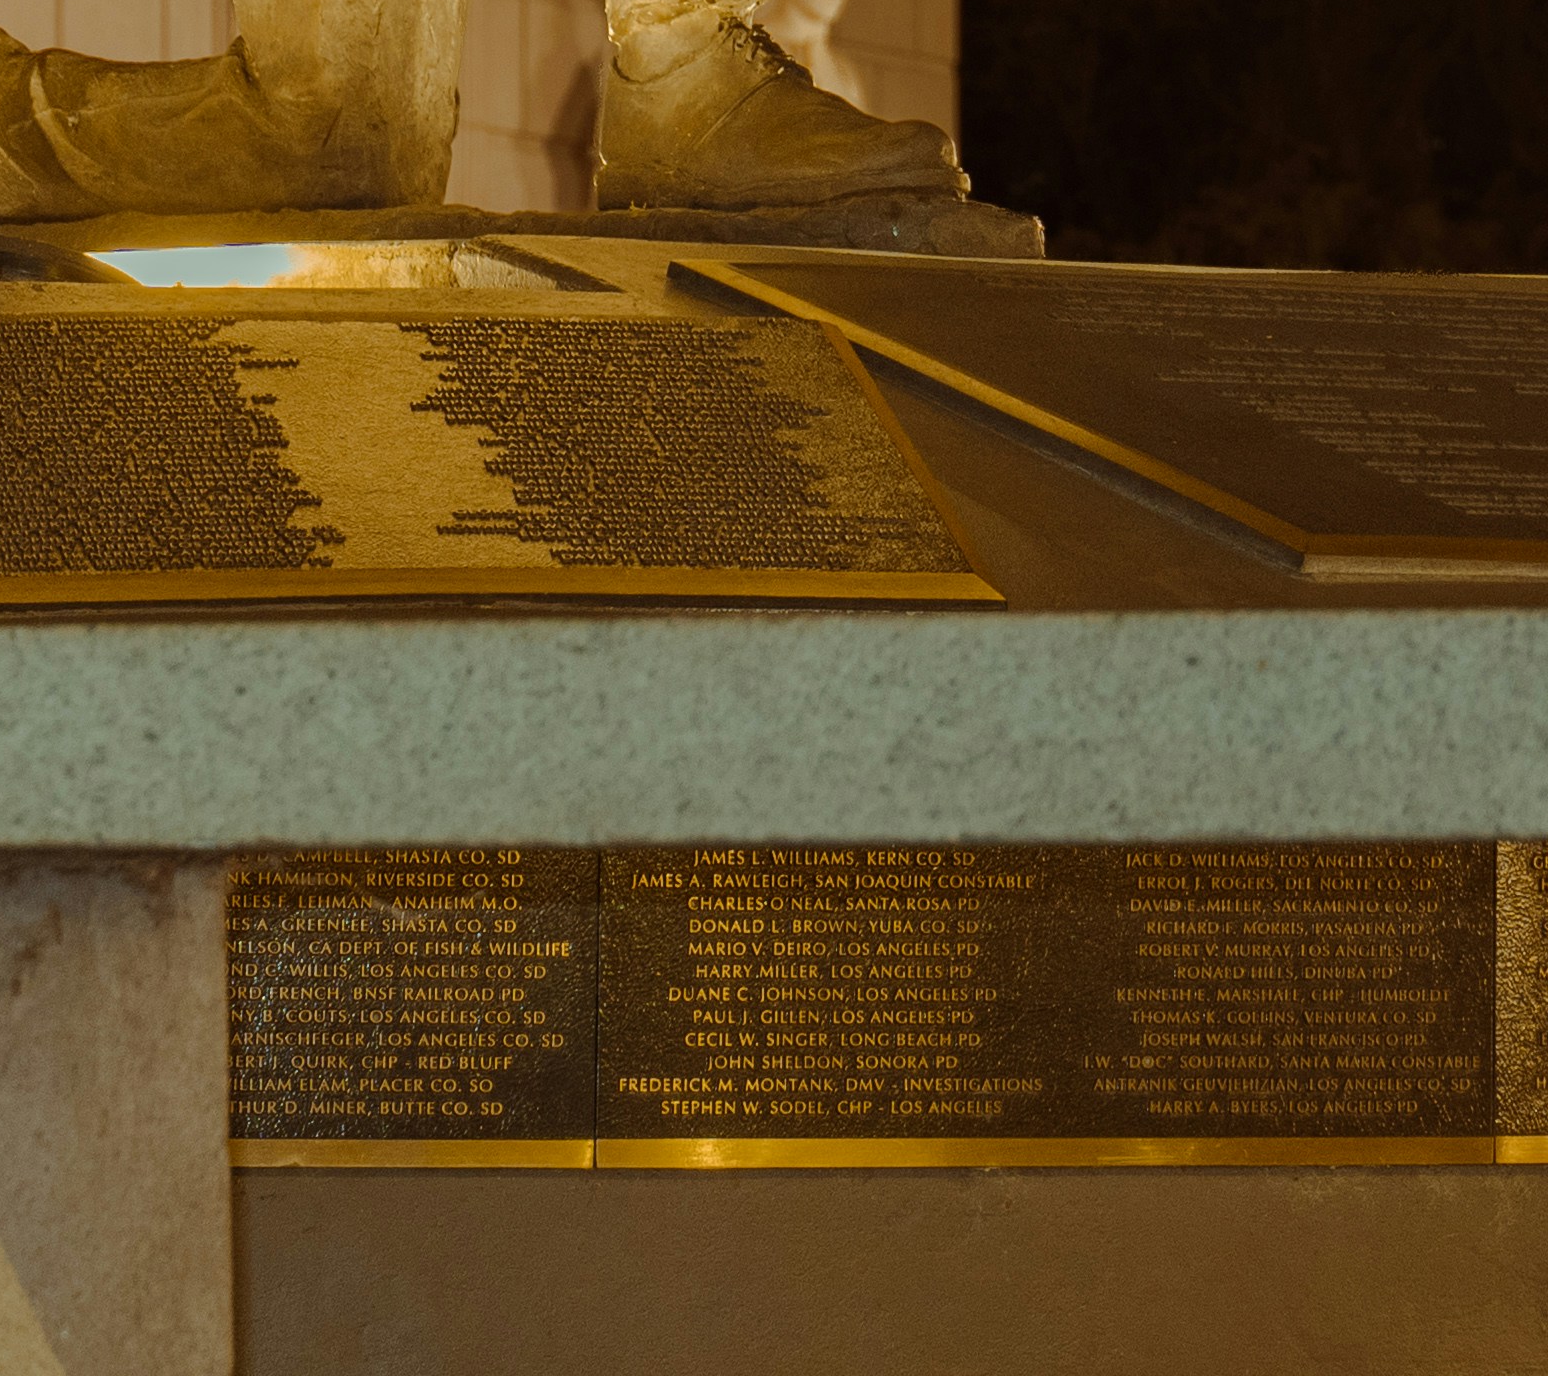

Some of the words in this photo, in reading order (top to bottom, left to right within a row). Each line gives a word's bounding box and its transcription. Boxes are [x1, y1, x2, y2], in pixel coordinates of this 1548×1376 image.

[384, 849, 452, 866] SHASTA
[496, 849, 521, 866] SD
[692, 849, 745, 868] JAMES
[751, 849, 766, 868] L.
[771, 849, 860, 868] WILLIAMS,
[866, 849, 910, 868] KERN
[915, 849, 946, 868] CO.
[951, 849, 975, 868] SD
[257, 872, 359, 889] HAMILTON,
[365, 872, 455, 889] RIVERSIDE
[461, 872, 494, 889] CO.
[500, 872, 524, 889] SD
[630, 873, 683, 891] JAMES
[687, 873, 706, 891] A.
[712, 873, 808, 891] RAWLEIGH,
[813, 873, 848, 891] SAN
[854, 873, 931, 891] JOAQUIN
[937, 873, 1036, 891] CONSTABLE
[686, 895, 763, 913] CHARLES
[770, 895, 838, 913] O'NEAL,
[844, 895, 901, 913] SANTA
[905, 895, 951, 913] ROSA
[956, 895, 980, 913] PD
[687, 918, 764, 935] DONALD
[771, 918, 785, 935] L.
[791, 918, 863, 935] BROWN,
[868, 918, 914, 935] YUBA
[919, 918, 949, 935] CO.
[956, 918, 979, 935] SD
[307, 940, 332, 958] CA
[393, 940, 418, 958] OF
[424, 940, 463, 958] FISH
[470, 940, 482, 958] &
[488, 940, 570, 958] WILDLIFE
[686, 940, 746, 958] MARIO
[751, 940, 767, 958] V.
[773, 940, 832, 958] DEIRO,
[837, 940, 870, 958] LOS
[875, 940, 950, 958] ANGELES
[955, 940, 979, 958] PD
[695, 963, 752, 981] HARRY
[757, 963, 824, 981] MILLER,
[830, 963, 863, 981] LOS
[868, 963, 943, 981] ANGELES
[948, 963, 972, 981] PD
[269, 986, 346, 1003] FRENCH,
[352, 986, 397, 1003] BNSF
[403, 986, 494, 1003] RAILROAD
[500, 986, 525, 1003] PD
[667, 986, 731, 1004] DUANE
[735, 986, 753, 1004] C.
[758, 986, 849, 1004] JOHNSON,
[856, 986, 888, 1004] LOS
[893, 986, 968, 1004] ANGELES
[973, 986, 997, 1004] PD
[262, 1009, 279, 1026] B.
[285, 1009, 352, 1026] COUTS,
[359, 1009, 394, 1026] LOS
[399, 1009, 478, 1026] ANGELES
[484, 1009, 516, 1026] CO.
[522, 1009, 547, 1026] SD
[692, 1009, 736, 1026] PAUL
[740, 1009, 752, 1026] J.
[759, 1009, 827, 1026] GILLEN,
[832, 1009, 864, 1026] LOS
[869, 1009, 944, 1026] ANGELES
[950, 1009, 974, 1026] PD
[684, 1031, 732, 1048] CECIL
[737, 1031, 759, 1048] W.
[765, 1031, 833, 1048] SINGER,
[839, 1031, 889, 1048] LONG
[895, 1031, 952, 1048] BEACH
[957, 1031, 981, 1048] PD
[290, 1054, 354, 1071] QUIRK,
[360, 1054, 398, 1071] CHP
[417, 1054, 452, 1071] RED
[458, 1054, 513, 1071] BLUFF
[706, 1054, 755, 1072] JOHN
[760, 1054, 849, 1072] SHELDON,
[854, 1054, 928, 1072] SONORA
[934, 1054, 958, 1072] PD
[298, 1077, 352, 1095] ELAM,
[358, 1077, 424, 1095] PLACER
[429, 1077, 462, 1095] CO.
[468, 1077, 493, 1095] SO
[618, 1077, 710, 1095] FREDERICK
[716, 1077, 738, 1095] M.
[744, 1077, 839, 1095] MONTANK,
[845, 1077, 885, 1095] DMV
[903, 1077, 1043, 1095] INVESTIGATIONS
[283, 1100, 301, 1117] D.
[309, 1100, 372, 1117] MINER,
[379, 1100, 435, 1117] BUTTE
[440, 1100, 473, 1117] CO.
[479, 1100, 503, 1117] SD
[660, 1100, 736, 1117] STEPHEN
[741, 1100, 763, 1117] W.
[769, 1100, 830, 1117] SODEL,
[836, 1100, 872, 1117] CHP
[890, 1100, 922, 1117] LOS
[927, 1100, 1002, 1117] ANGELES
